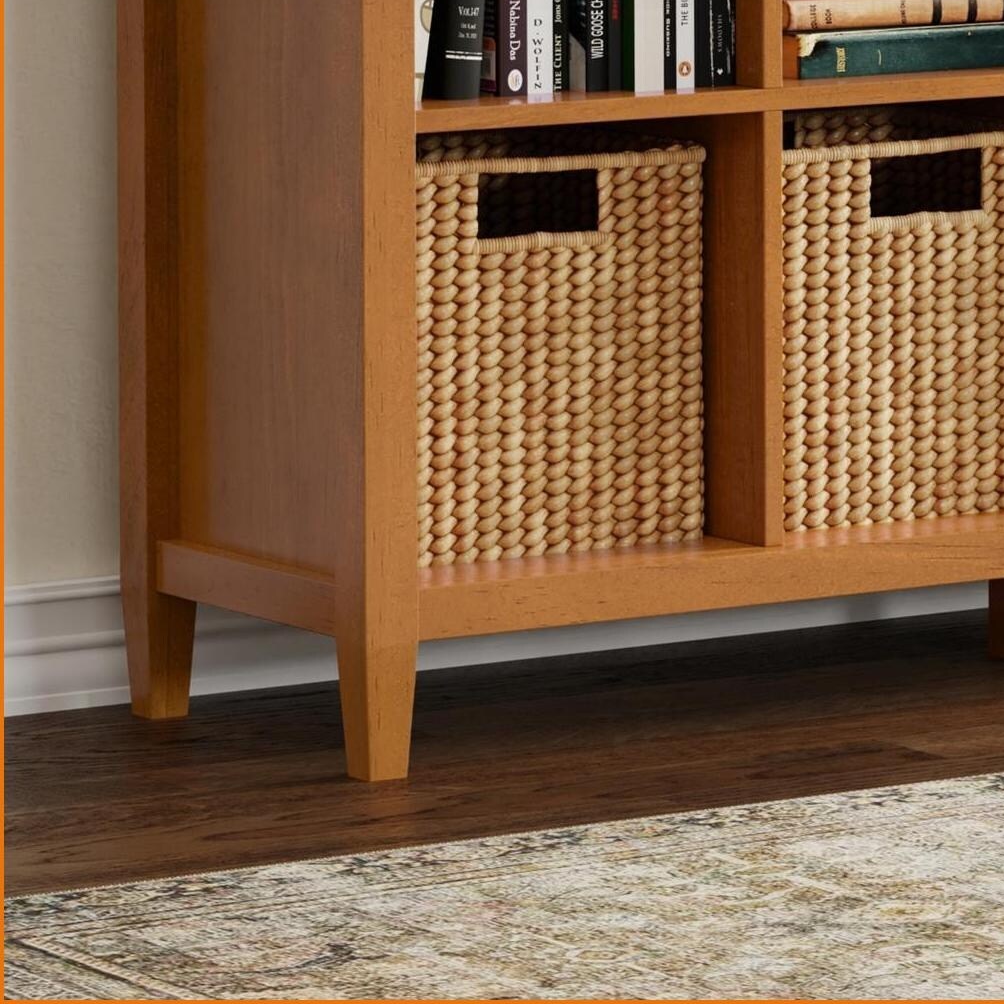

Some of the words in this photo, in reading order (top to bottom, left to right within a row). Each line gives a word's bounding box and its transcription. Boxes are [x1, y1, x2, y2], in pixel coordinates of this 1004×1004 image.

[509, 0, 521, 38] Nabina
[591, 10, 605, 37] GOOSE
[680, 10, 689, 26] THE
[509, 40, 521, 61] Das
[553, 35, 562, 68] CLIENT
[591, 38, 605, 60] WILD
[554, 71, 562, 91] THE
